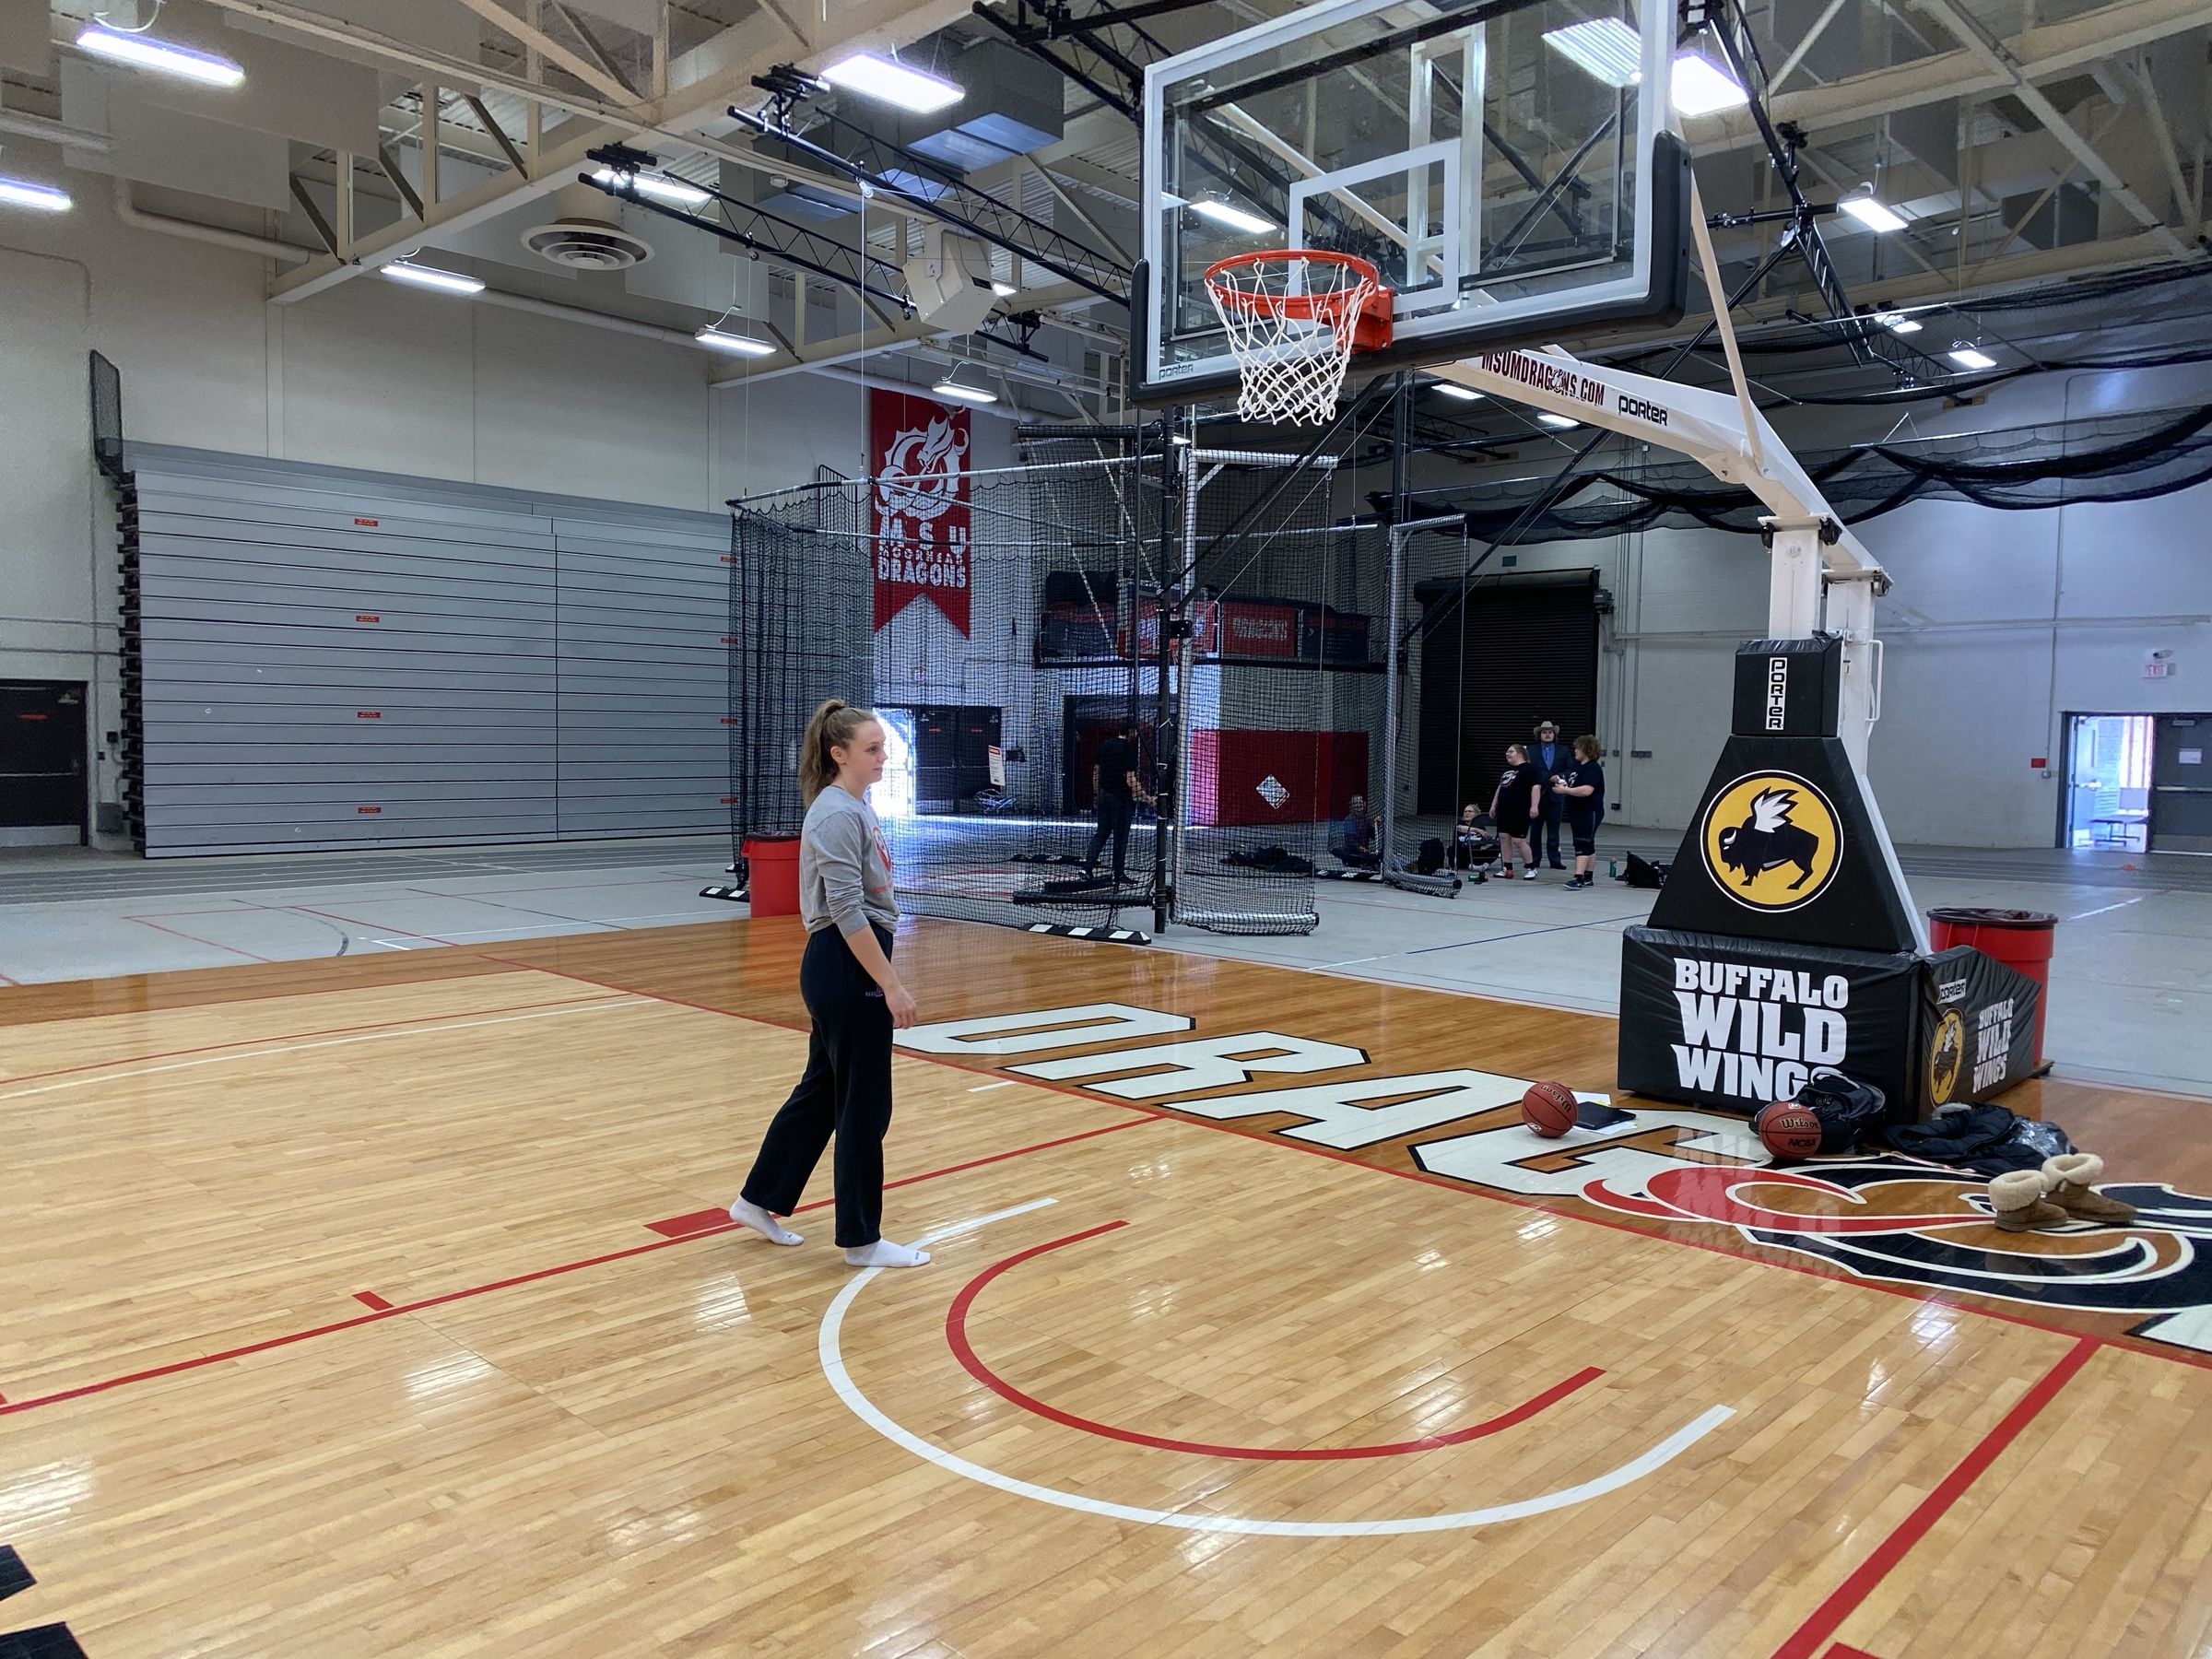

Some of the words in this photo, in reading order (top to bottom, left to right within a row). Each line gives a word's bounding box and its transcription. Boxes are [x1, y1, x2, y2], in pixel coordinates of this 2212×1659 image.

[877, 556, 966, 588] DRAGONS
[1674, 958, 1849, 1009] BUFFALO
[1672, 991, 1847, 1065] WILD
[1978, 997, 2014, 1030] BUFFALO
[1977, 1020, 2012, 1065] WILD
[1972, 1053, 2007, 1094] WINGS
[1541, 1085, 1572, 1112] Wilson
[1781, 1118, 1819, 1129] Wilson
[1789, 1137, 1817, 1147] NCAA
